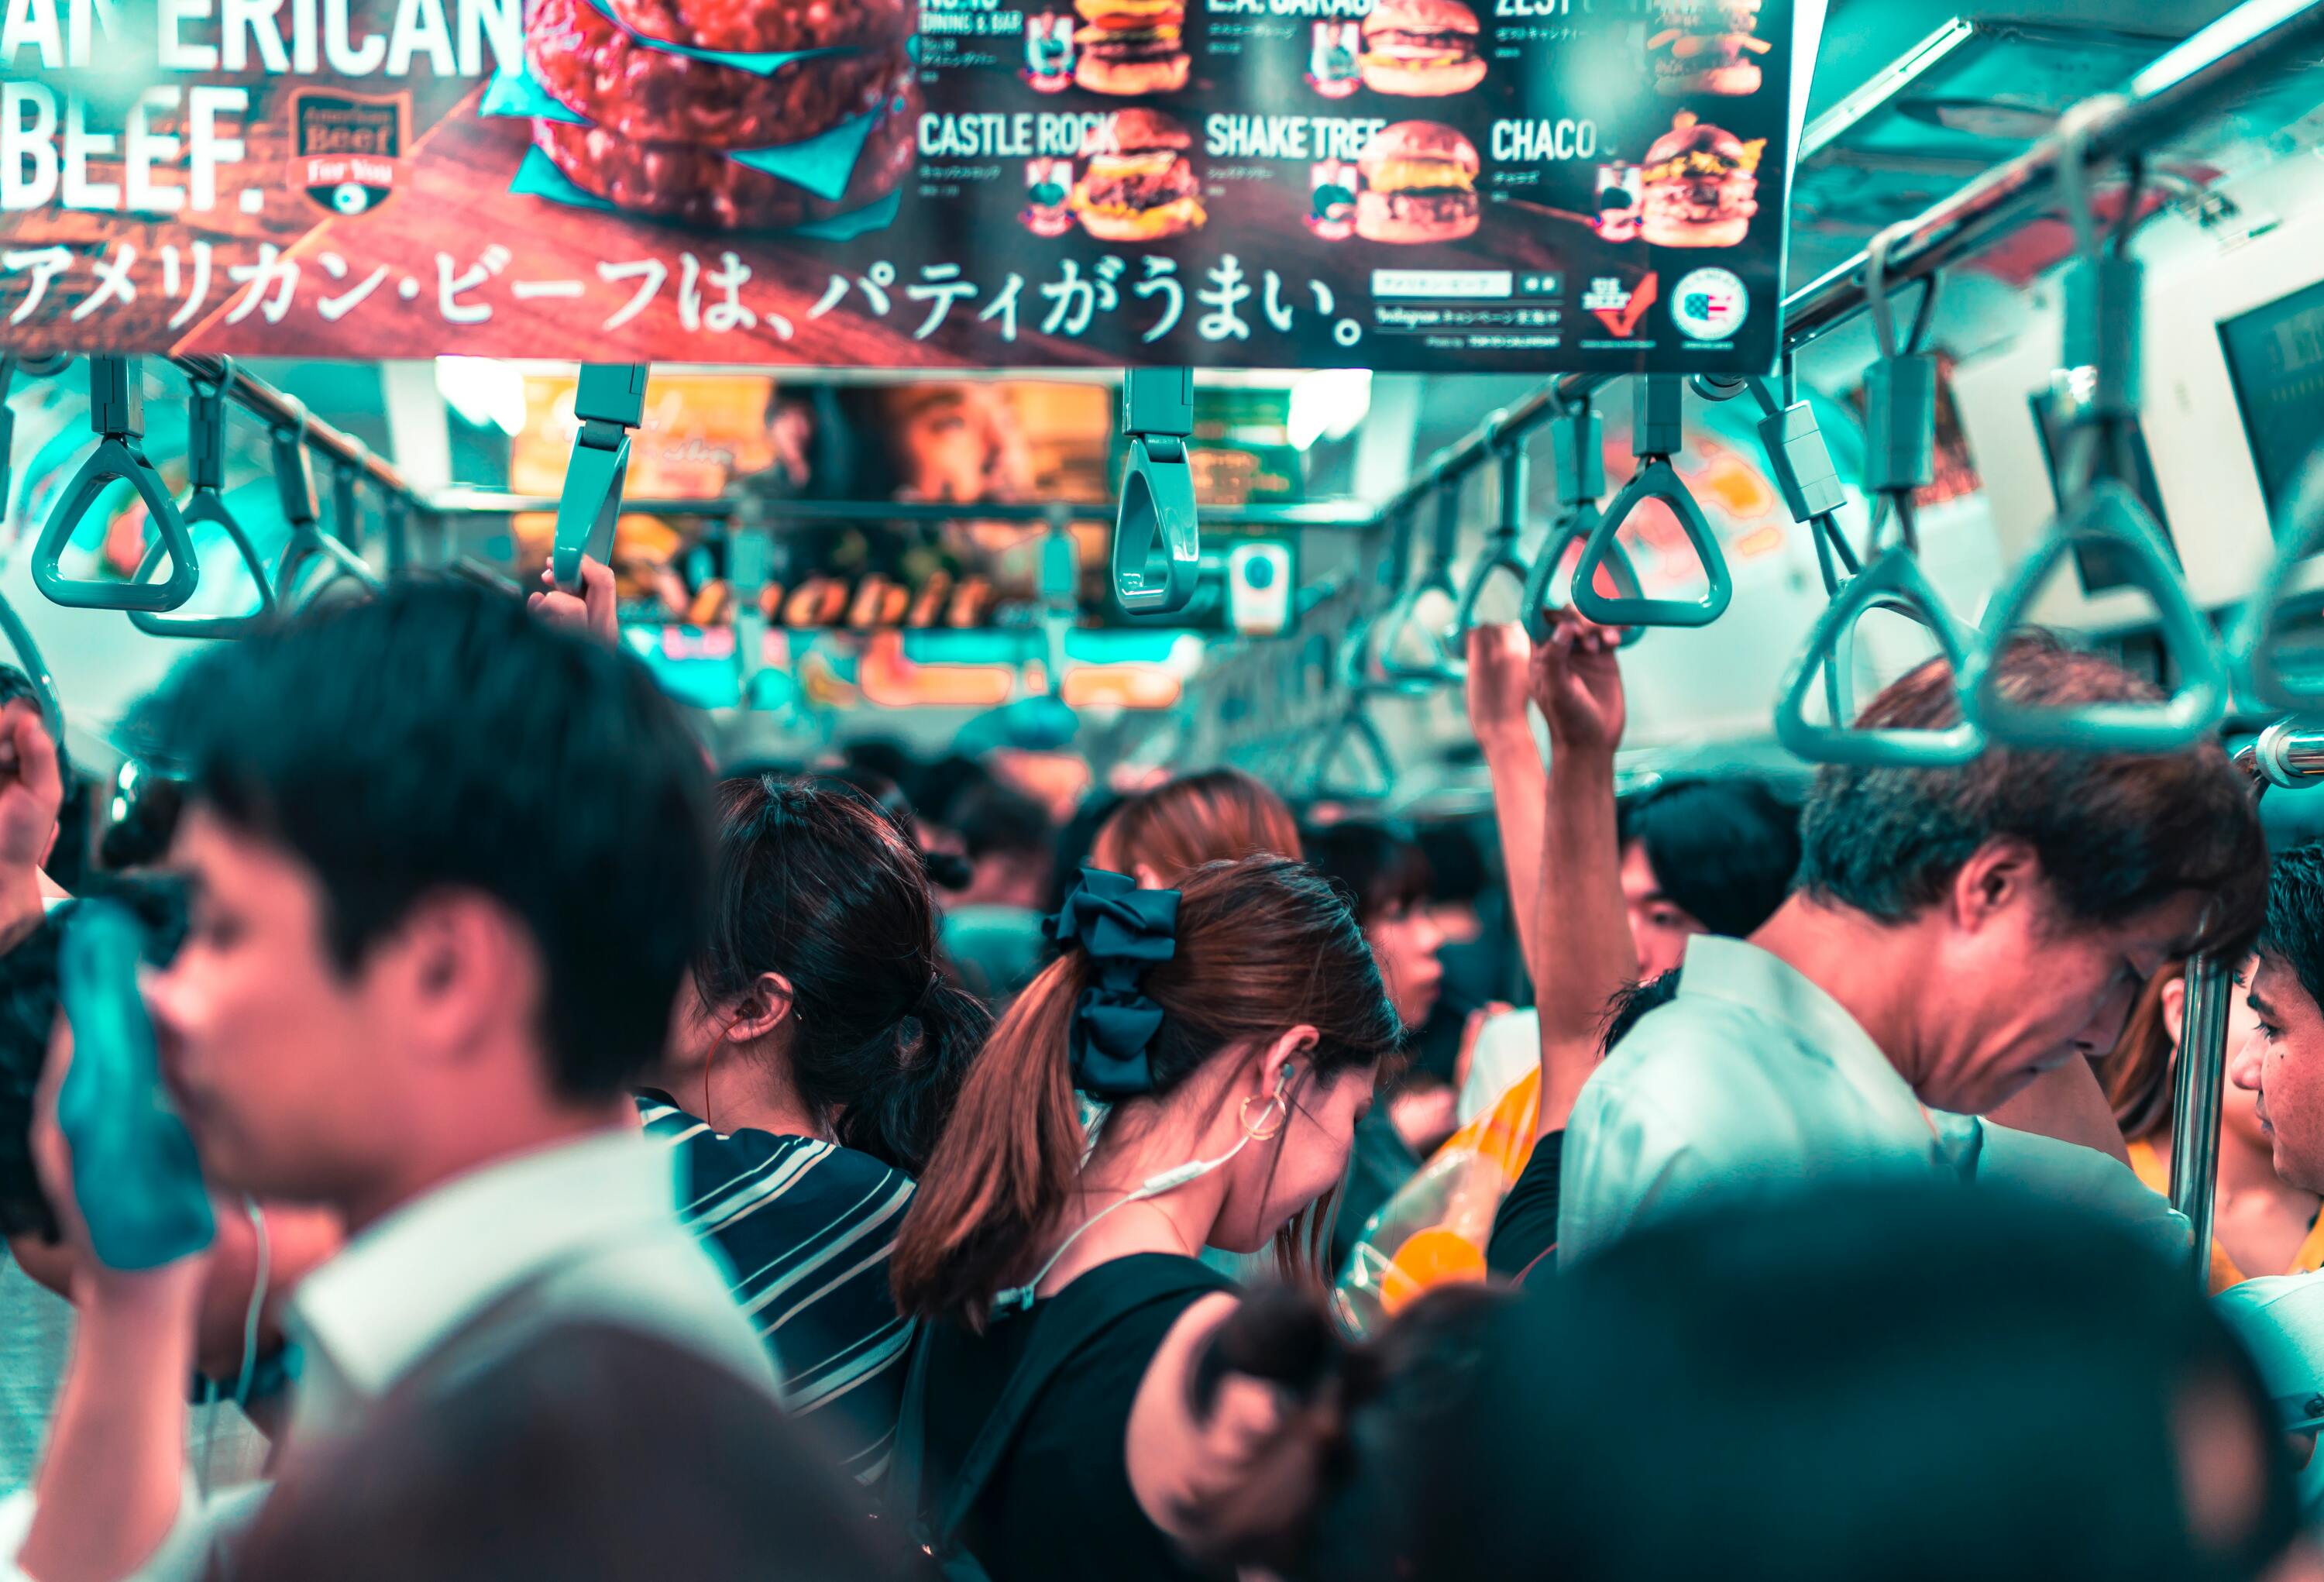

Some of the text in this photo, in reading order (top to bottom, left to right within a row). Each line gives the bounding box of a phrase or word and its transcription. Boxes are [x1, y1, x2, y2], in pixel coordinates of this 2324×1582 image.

[0, 0, 517, 75] AERICAN
[0, 84, 264, 212] BEEF.
[919, 113, 1120, 155] CASTLE ROCK
[1205, 115, 1309, 158] SHAKE
[1491, 119, 1617, 161] CHACO
